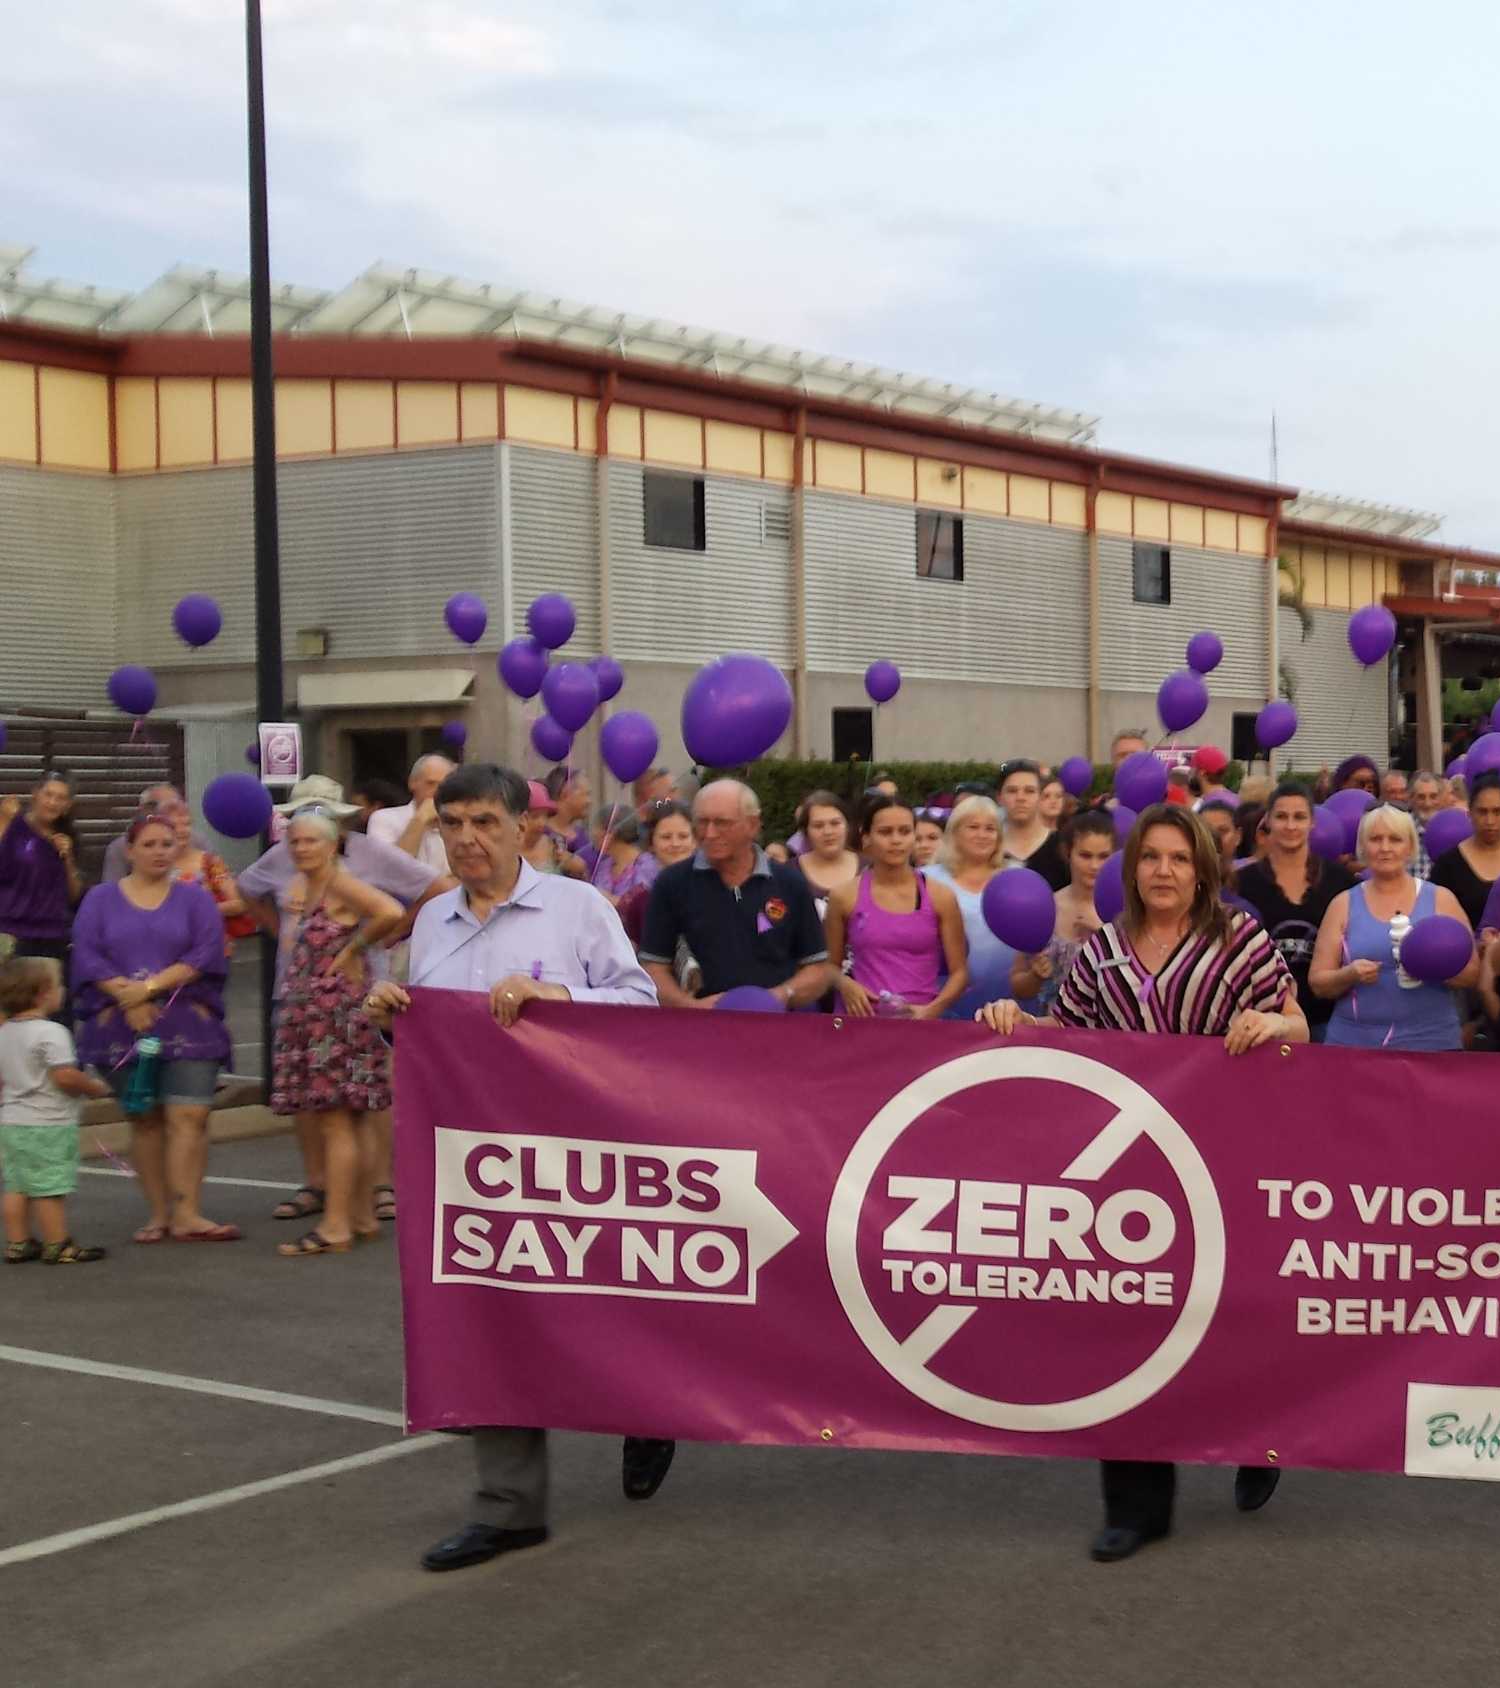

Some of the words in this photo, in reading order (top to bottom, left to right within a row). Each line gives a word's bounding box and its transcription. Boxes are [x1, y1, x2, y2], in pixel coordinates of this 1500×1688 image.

[464, 1143, 721, 1213] CLUBS
[1257, 1179, 1333, 1222] TO
[450, 1213, 602, 1278] SAY
[621, 1227, 741, 1288] NO
[882, 1175, 1176, 1264] ZERO
[882, 1259, 1174, 1305] TOLERANCE
